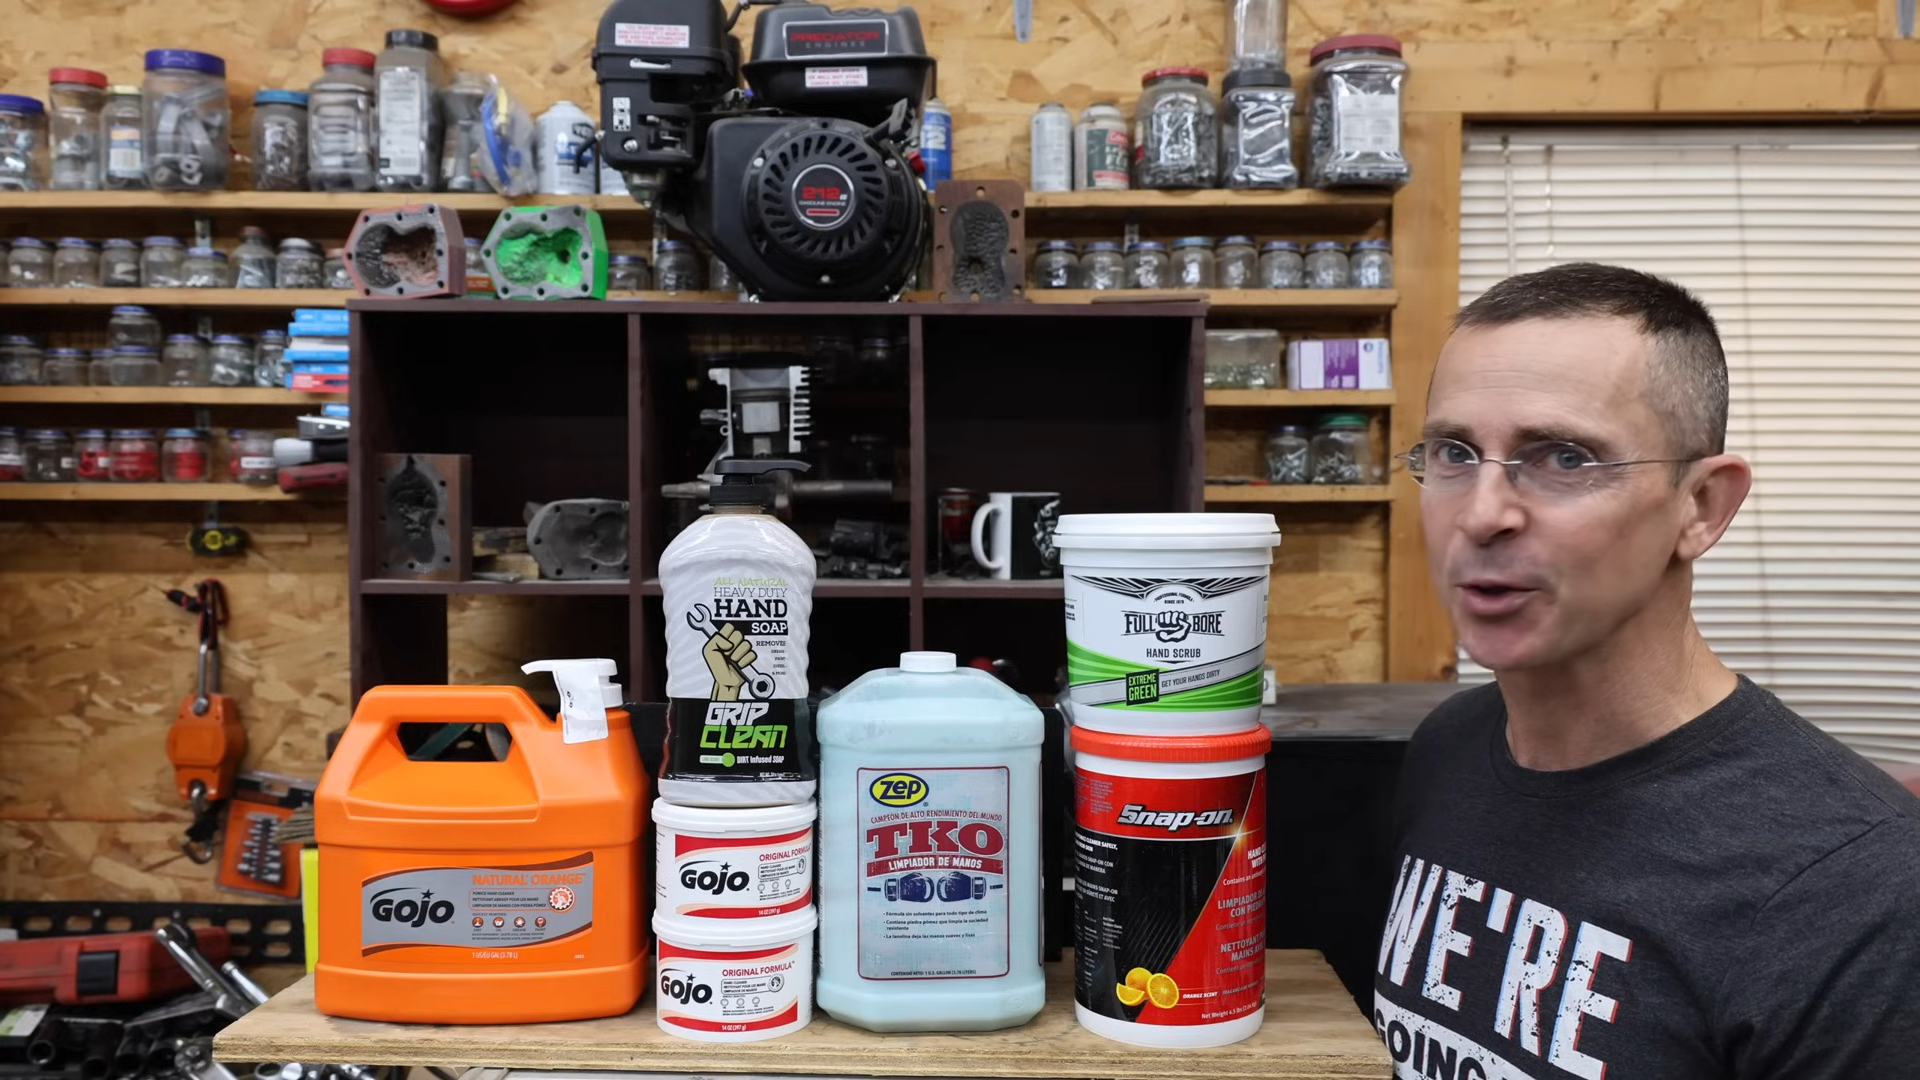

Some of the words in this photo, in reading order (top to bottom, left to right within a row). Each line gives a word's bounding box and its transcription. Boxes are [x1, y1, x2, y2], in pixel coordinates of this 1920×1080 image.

[790, 31, 881, 42] PREDATOR
[802, 186, 840, 200] 212
[738, 577, 788, 586] NATURAL
[714, 587, 756, 598] HEAVY
[758, 588, 788, 598] DUTY
[714, 598, 788, 618] HAND
[752, 622, 788, 634] SOAP
[1124, 613, 1156, 634] FULL
[1192, 613, 1222, 634] BORE
[1146, 648, 1170, 658] HAND
[1172, 648, 1201, 658] SCRUB
[1128, 673, 1156, 686] EXTREME
[1162, 680, 1172, 688] GET
[1172, 677, 1187, 686] YOUR
[1188, 674, 1206, 684] HANDS
[1206, 669, 1220, 679] DIRTY
[1128, 684, 1157, 700] GREEN
[704, 702, 770, 726] GRIP
[700, 725, 788, 749] CLEAN
[736, 756, 750, 764] DIRT
[772, 756, 784, 764] SOAP
[871, 812, 900, 824] CAMPEÓN
[981, 812, 1002, 822] MUNDO
[1118, 804, 1234, 831] Snap-on
[866, 820, 1005, 860] TKO
[759, 852, 791, 862] ORIGINAL
[888, 857, 935, 871] LIMPIADOR
[938, 857, 949, 866] DE
[952, 858, 982, 868] MANOS
[472, 874, 528, 886] NATURAL
[530, 873, 582, 884] ORANGE
[680, 867, 750, 896] GOJO
[1222, 876, 1246, 886] Contains
[372, 888, 454, 928] GOJO
[1218, 892, 1258, 910] LIMPIADOR
[1230, 906, 1246, 918] CON
[1220, 934, 1259, 953] NETTOYANT
[1232, 946, 1254, 962] MAINS
[722, 968, 759, 977] ORIGINAL
[760, 962, 792, 974] FORMULA
[1377, 854, 1633, 1080] WE'RE
[660, 974, 712, 1005] GOJO
[1212, 1010, 1228, 1018] Weight
